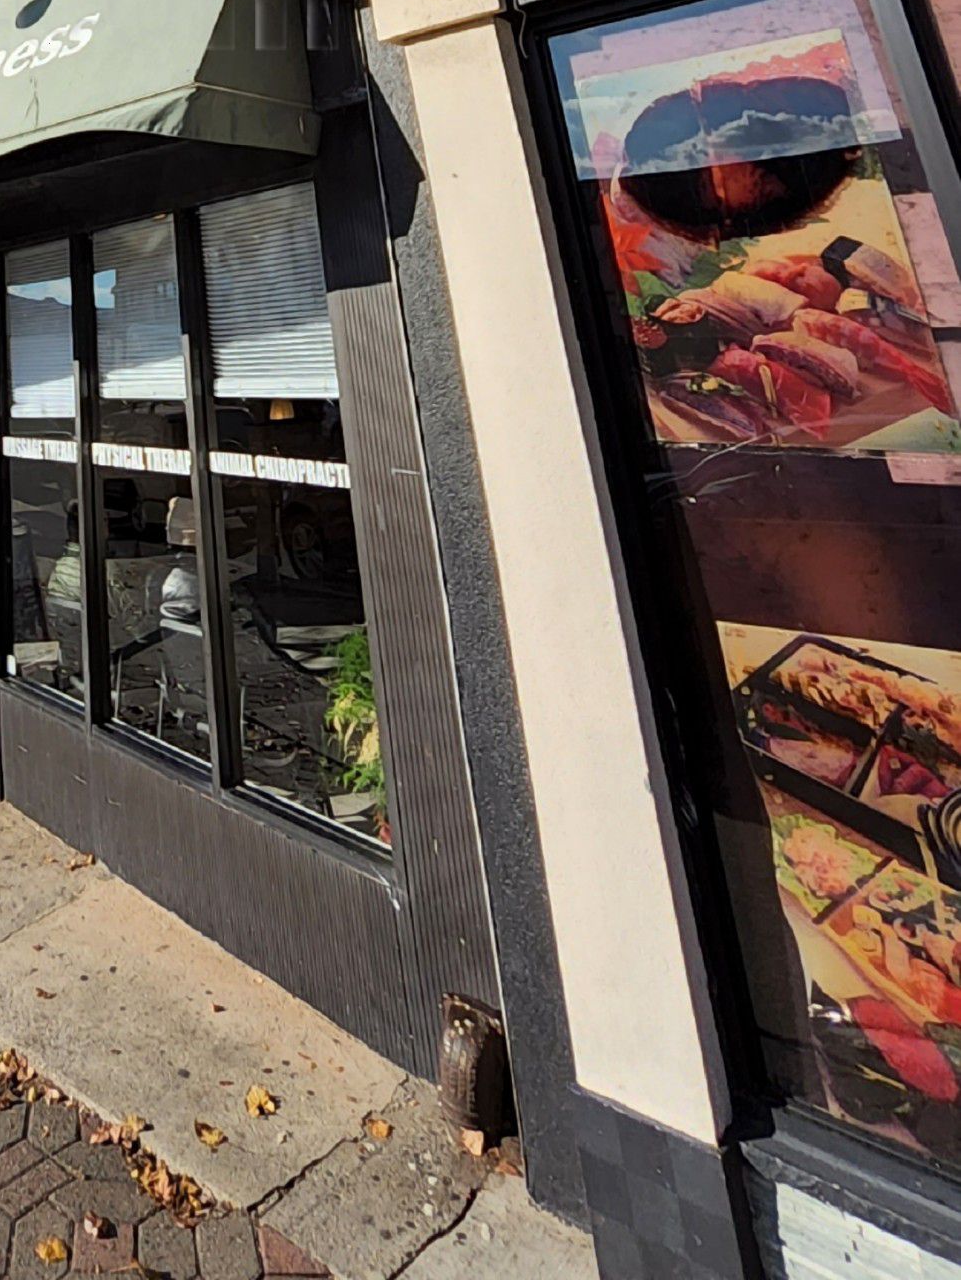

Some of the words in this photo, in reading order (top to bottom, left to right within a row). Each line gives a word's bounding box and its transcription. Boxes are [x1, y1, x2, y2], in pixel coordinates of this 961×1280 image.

[91, 442, 145, 470] PHYSICAL
[209, 451, 256, 477] ANIMAL
[254, 454, 352, 489] CHIROPRACTI
